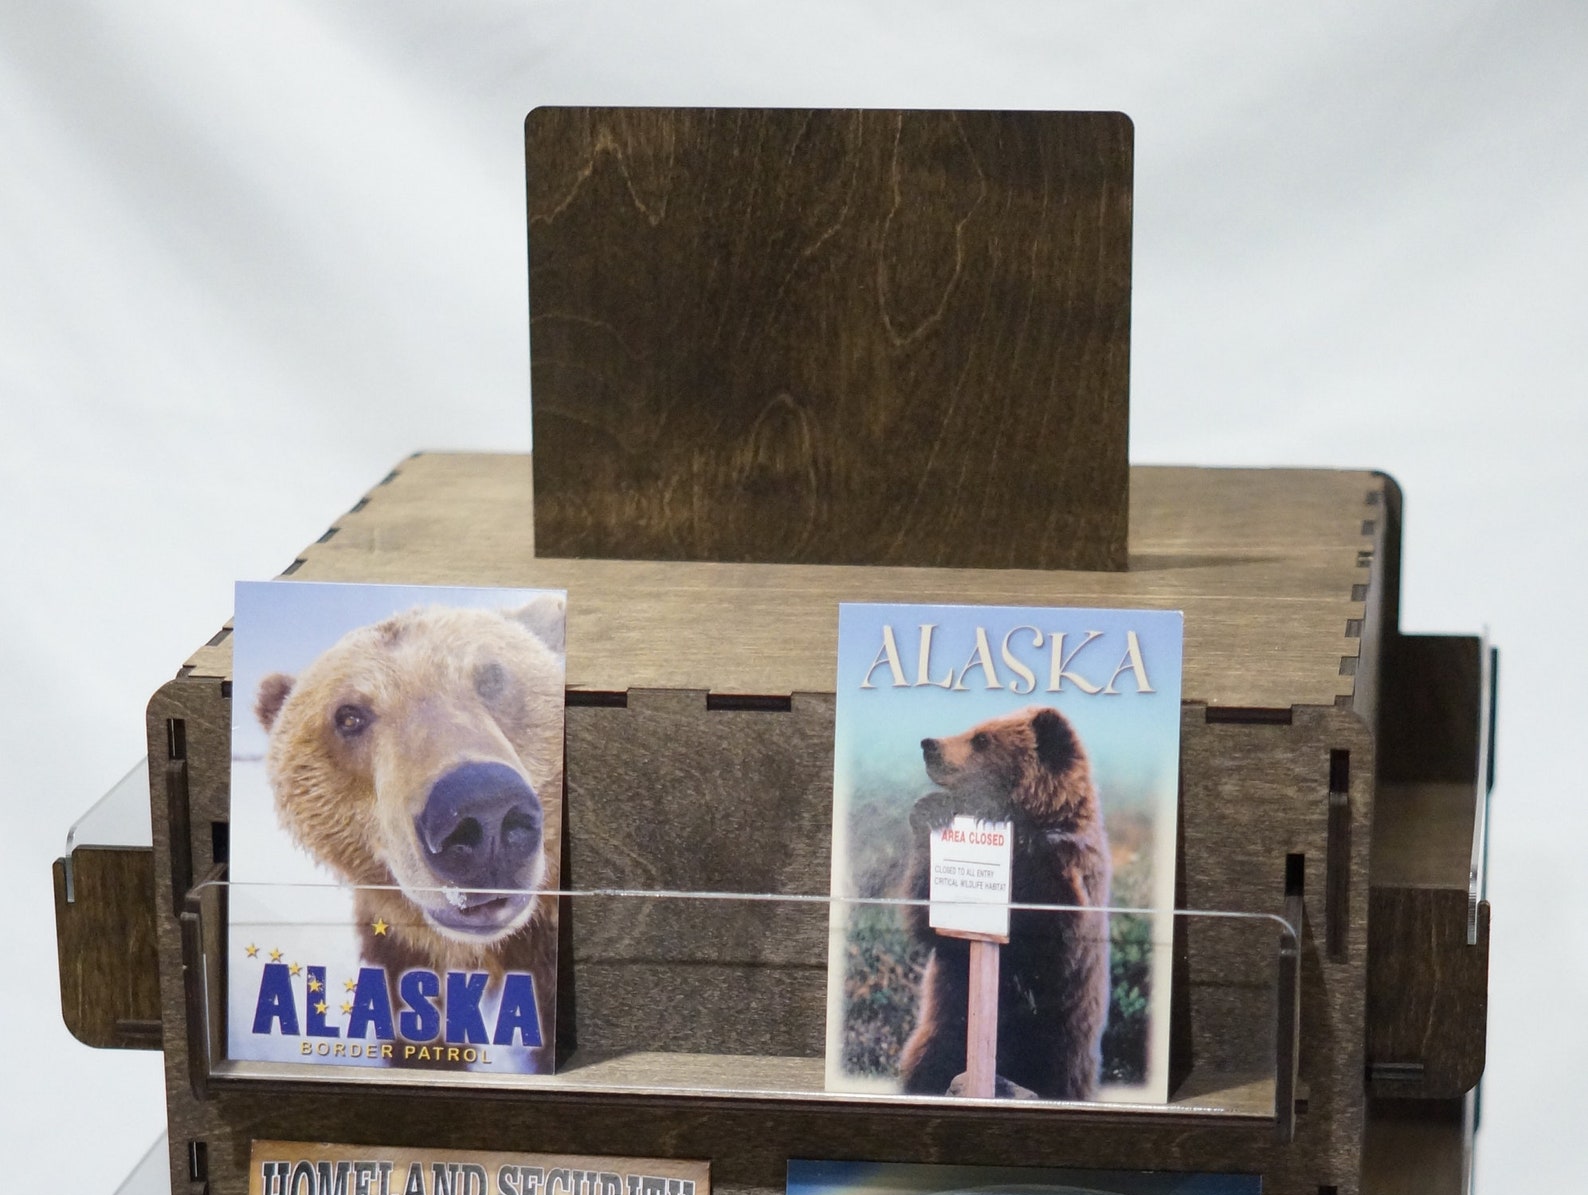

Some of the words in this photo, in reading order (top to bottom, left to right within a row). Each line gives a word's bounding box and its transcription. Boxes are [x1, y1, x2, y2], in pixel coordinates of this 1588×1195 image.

[860, 624, 1157, 695] ALASKA
[942, 829, 966, 843] AREA
[969, 832, 1005, 846] CLOSED
[935, 865, 957, 875] CLOSED
[958, 866, 966, 876] TO
[966, 867, 975, 877] ALL
[977, 869, 995, 878] ENTRY
[935, 876, 959, 887] CRITICAL
[960, 878, 984, 890] WILDLIFE
[251, 963, 543, 1047] ALASKA
[301, 1041, 394, 1059] BORDER
[404, 1045, 493, 1064] PATROL
